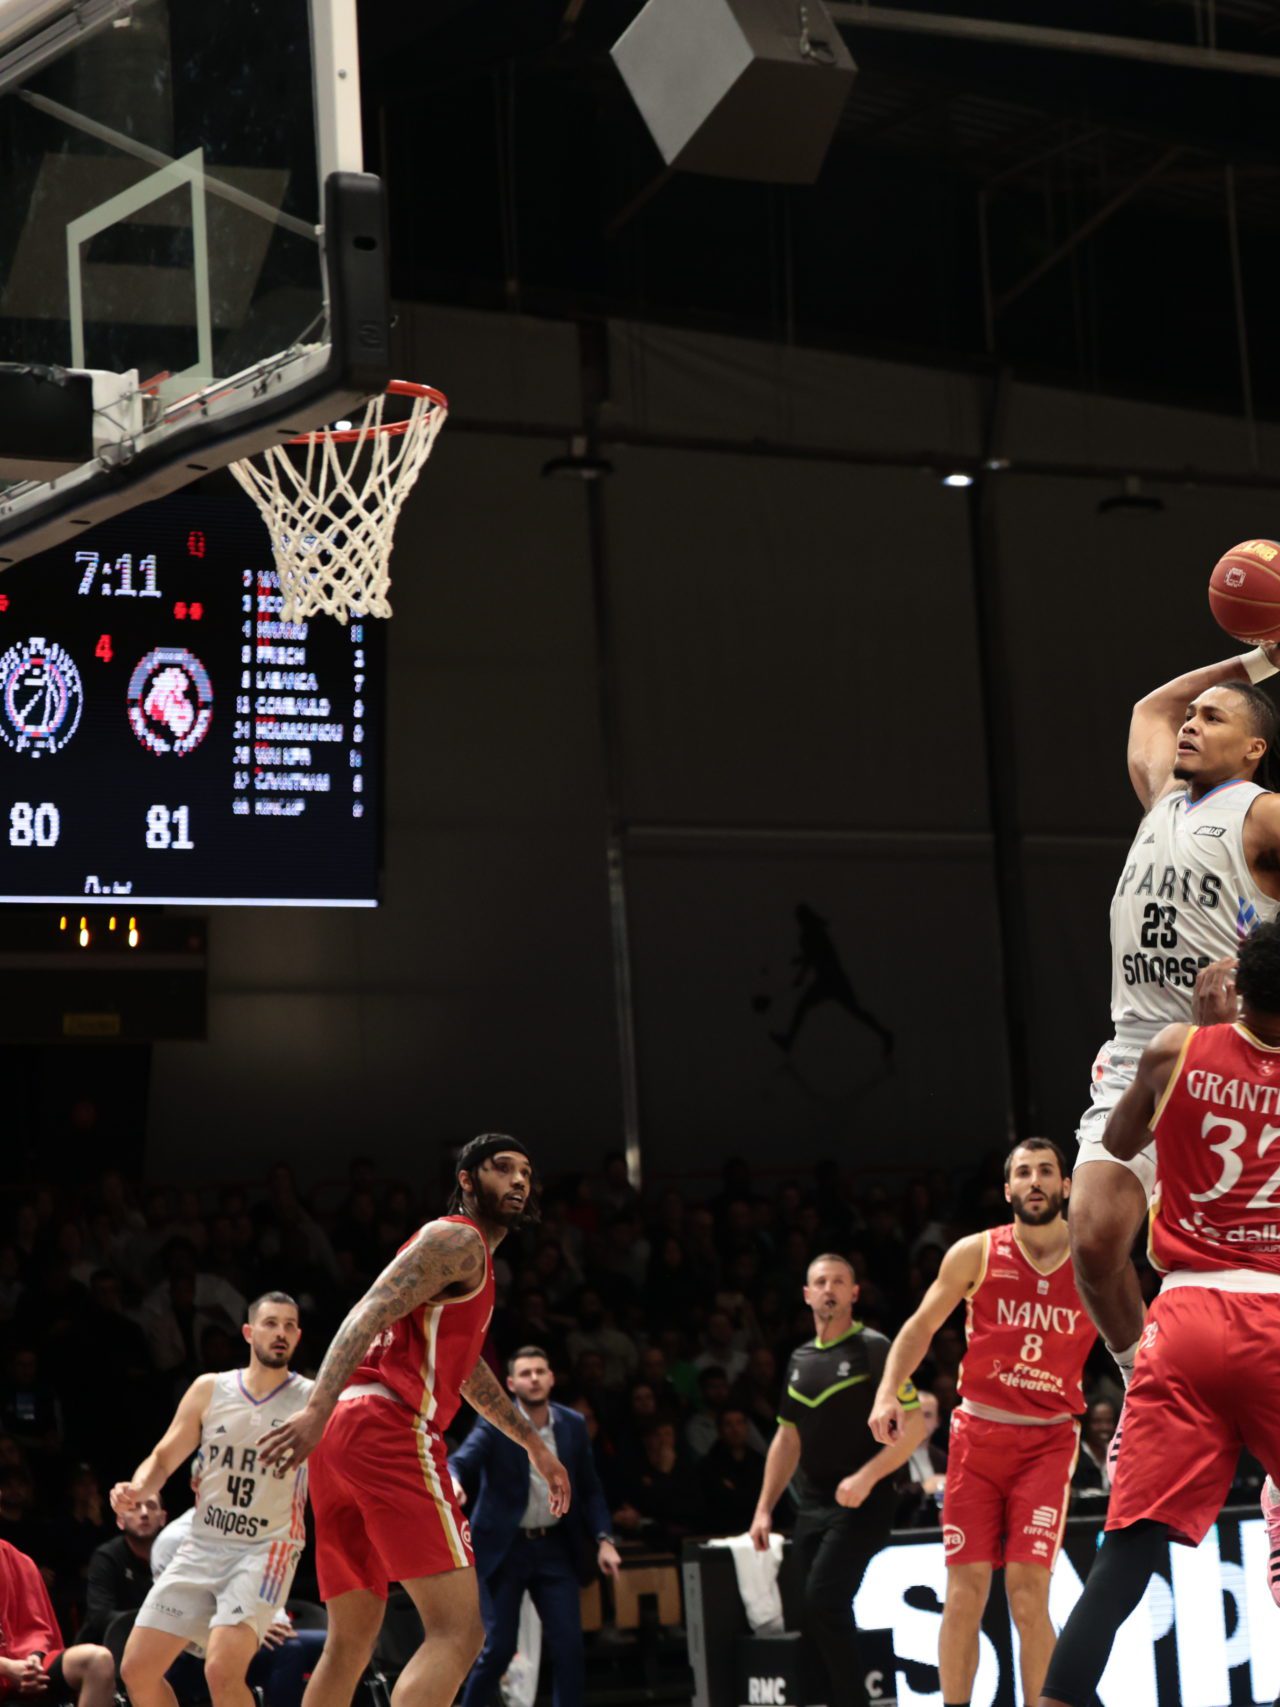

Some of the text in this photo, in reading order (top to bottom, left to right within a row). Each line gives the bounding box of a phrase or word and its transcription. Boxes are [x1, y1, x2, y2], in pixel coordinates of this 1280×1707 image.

[75, 551, 162, 597] 7:11
[95, 634, 114, 663] 4
[9, 802, 61, 848] 80
[146, 804, 195, 849] 81
[1118, 863, 1222, 909] PARIS
[1140, 902, 1178, 949] 23
[997, 1298, 1081, 1336] NANCY
[1020, 1333, 1043, 1363] 8
[227, 1475, 255, 1508] 43
[203, 1503, 259, 1538] snipes
[748, 1676, 787, 1706] RMC
